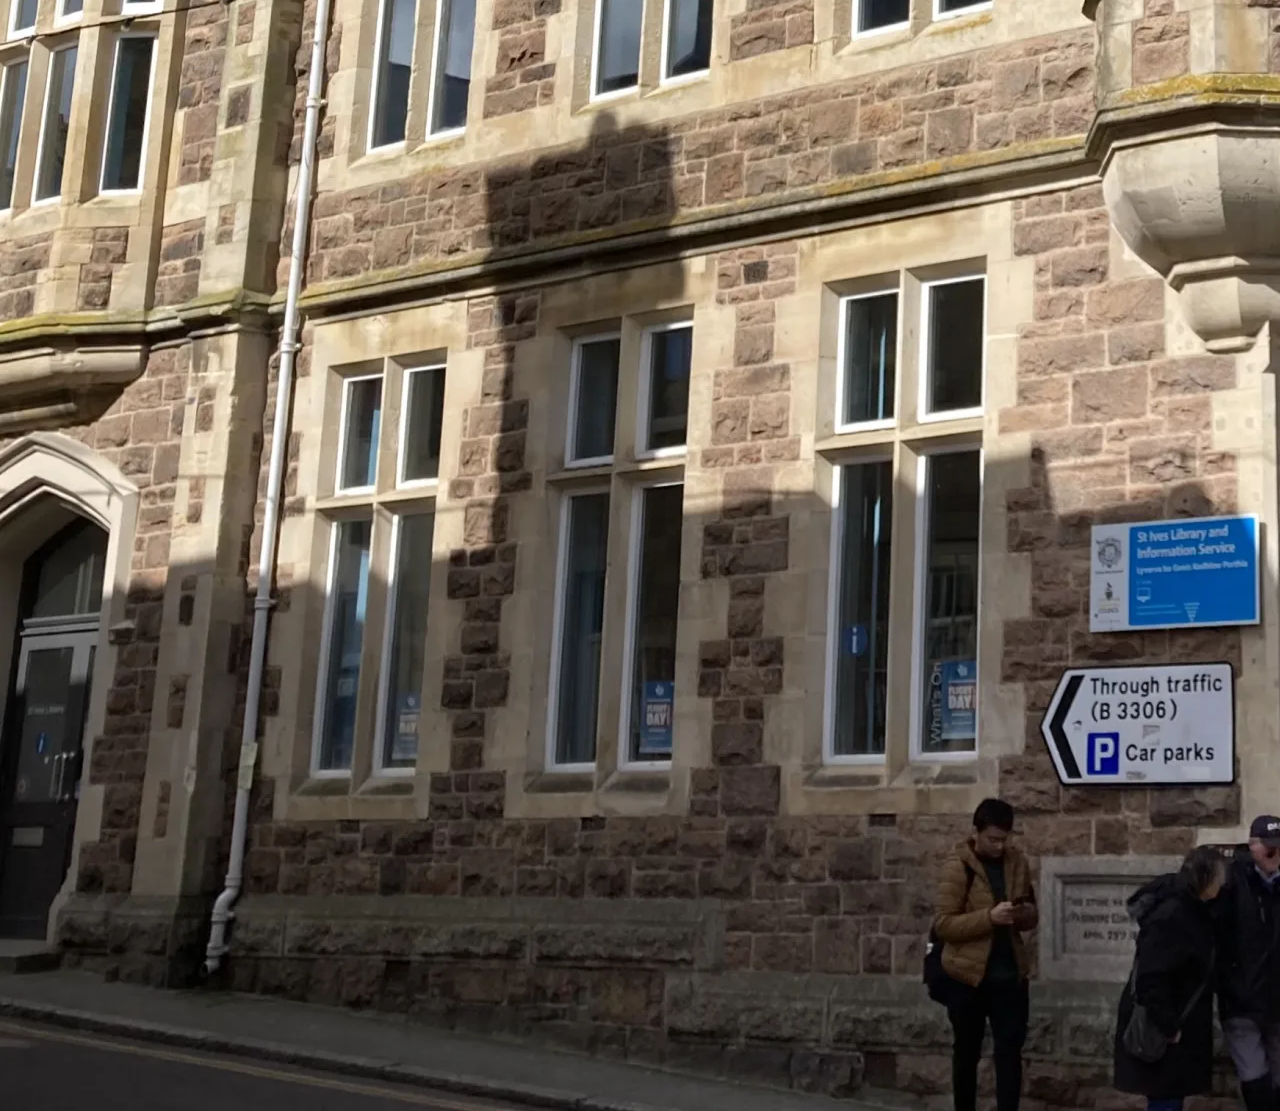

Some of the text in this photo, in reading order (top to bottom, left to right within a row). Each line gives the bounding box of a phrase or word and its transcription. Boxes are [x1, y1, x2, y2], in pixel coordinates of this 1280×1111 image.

[1137, 524, 1229, 543] St Ives Library and
[1137, 542, 1236, 559] Information Service
[1090, 674, 1223, 698] Through traffic
[1094, 737, 1215, 772] P Car parks
